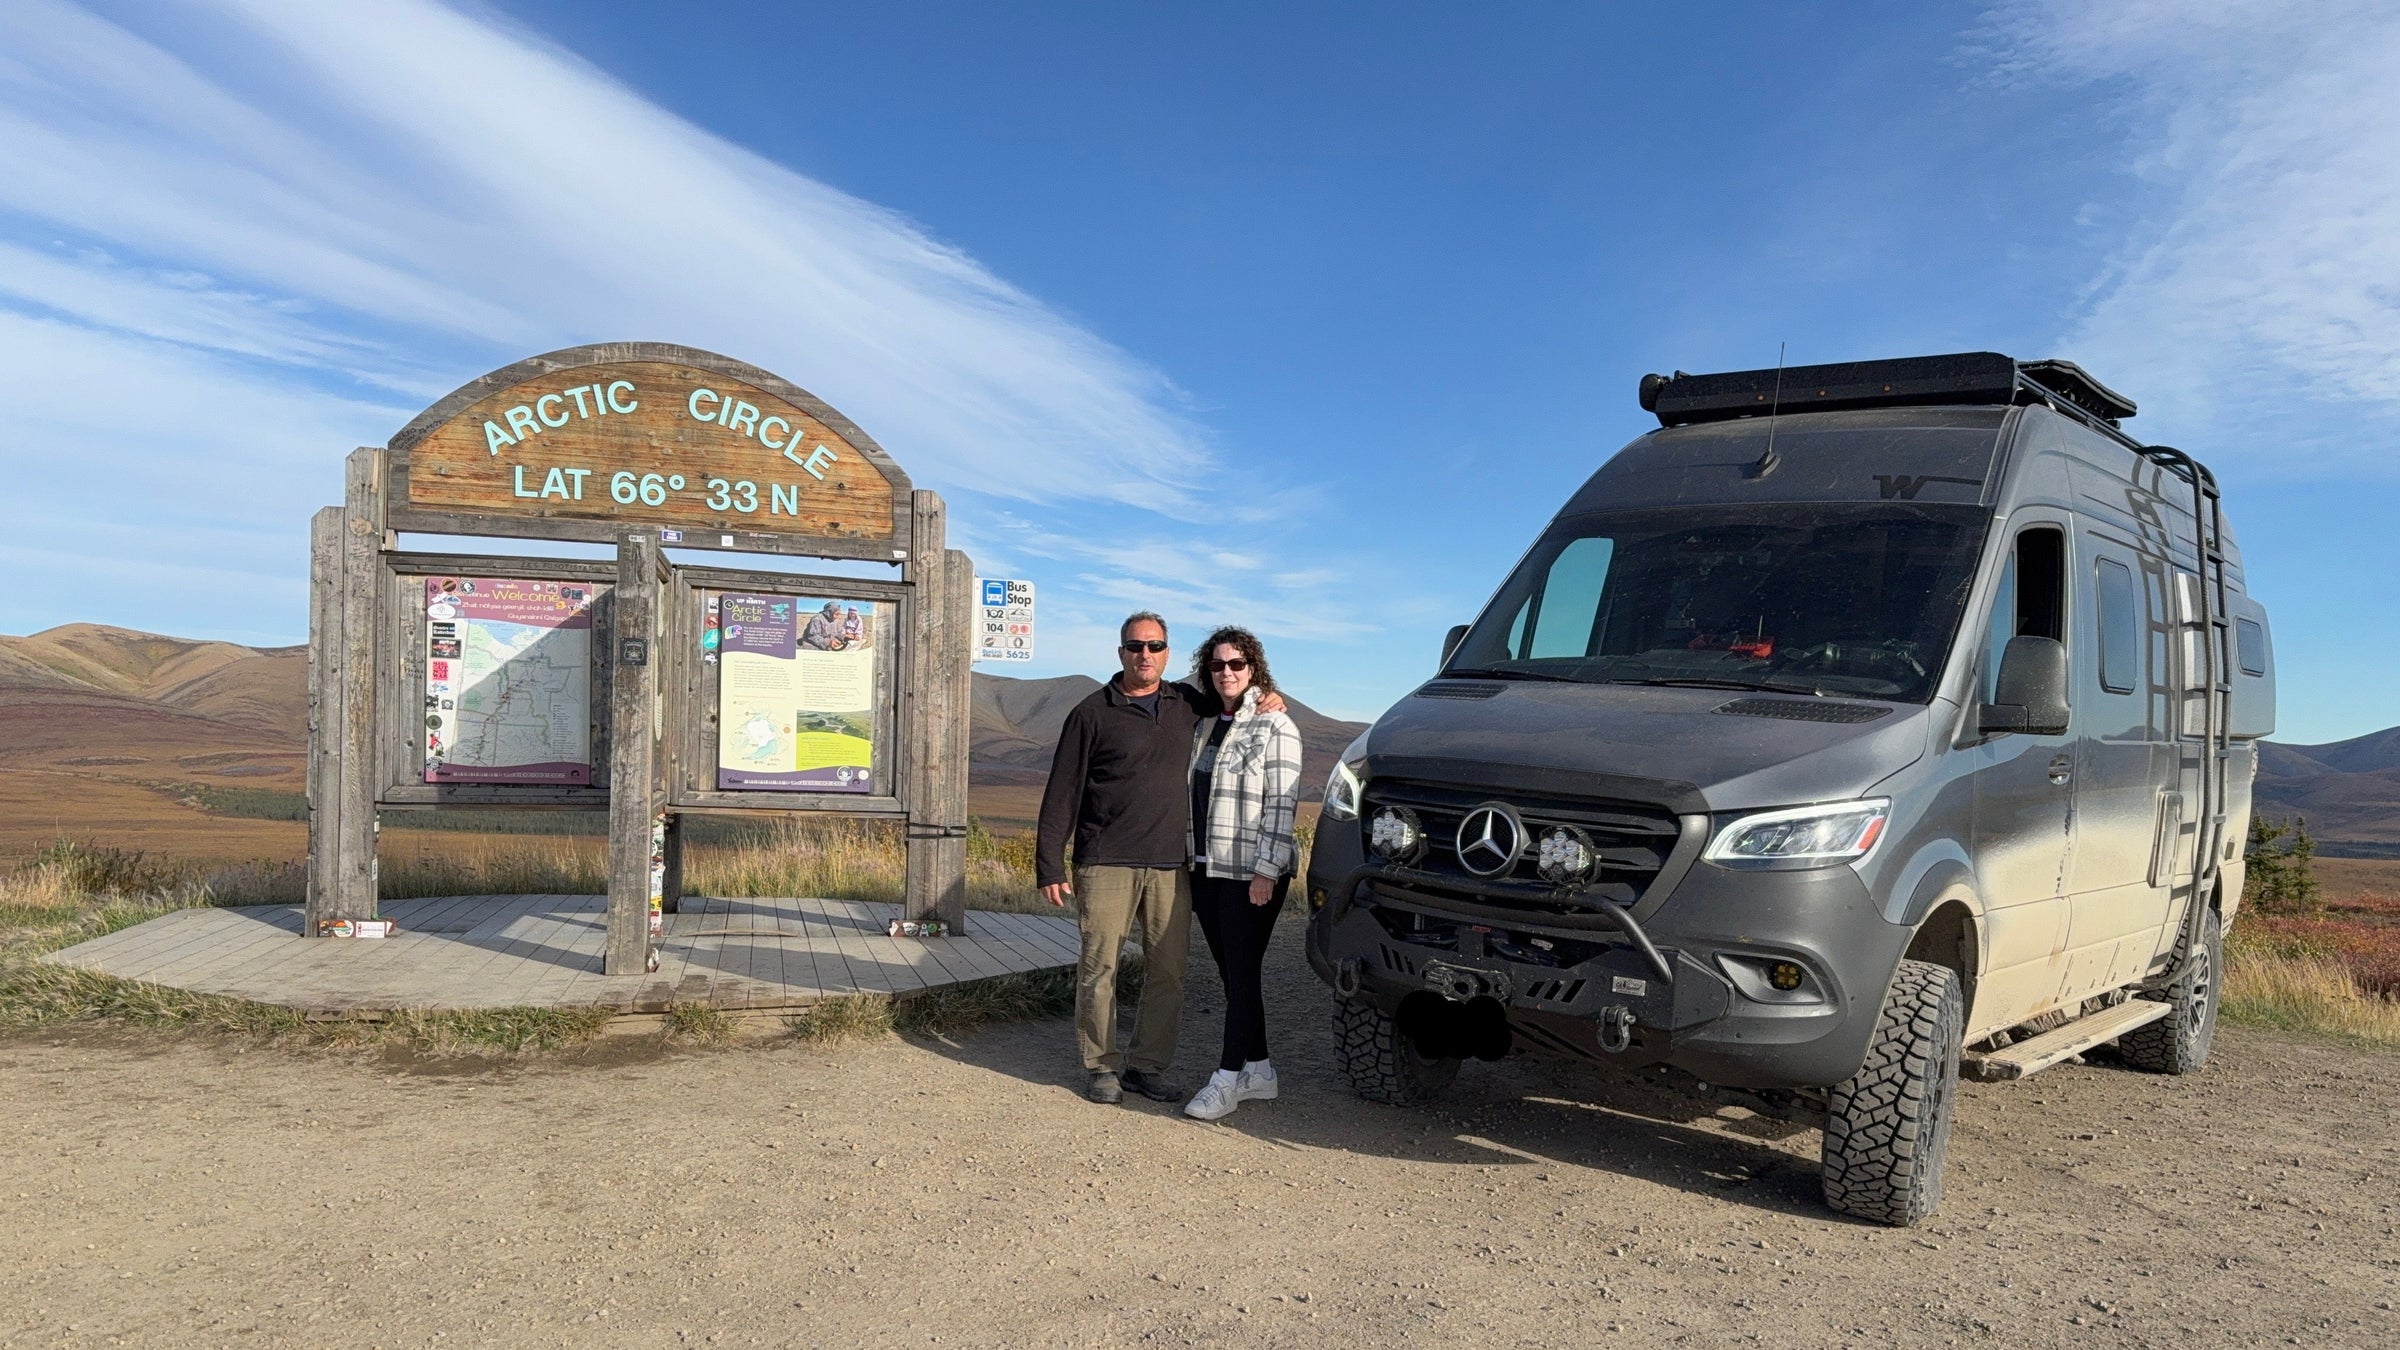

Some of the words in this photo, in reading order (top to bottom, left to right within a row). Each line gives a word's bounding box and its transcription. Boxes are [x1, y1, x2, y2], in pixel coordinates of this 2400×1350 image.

[483, 380, 638, 457] ARCTIC
[688, 388, 839, 481] CIRCLE
[514, 465, 592, 500] LAT
[610, 471, 686, 507] 66°
[706, 478, 759, 513] 33
[771, 483, 798, 516] N
[1007, 580, 1028, 592] Bus
[491, 588, 560, 603] Welcome
[1007, 593, 1032, 607] Stop
[731, 604, 767, 615] Arctic
[731, 613, 762, 623] Circle
[986, 623, 1004, 633] 104
[1006, 650, 1030, 659] 5625
